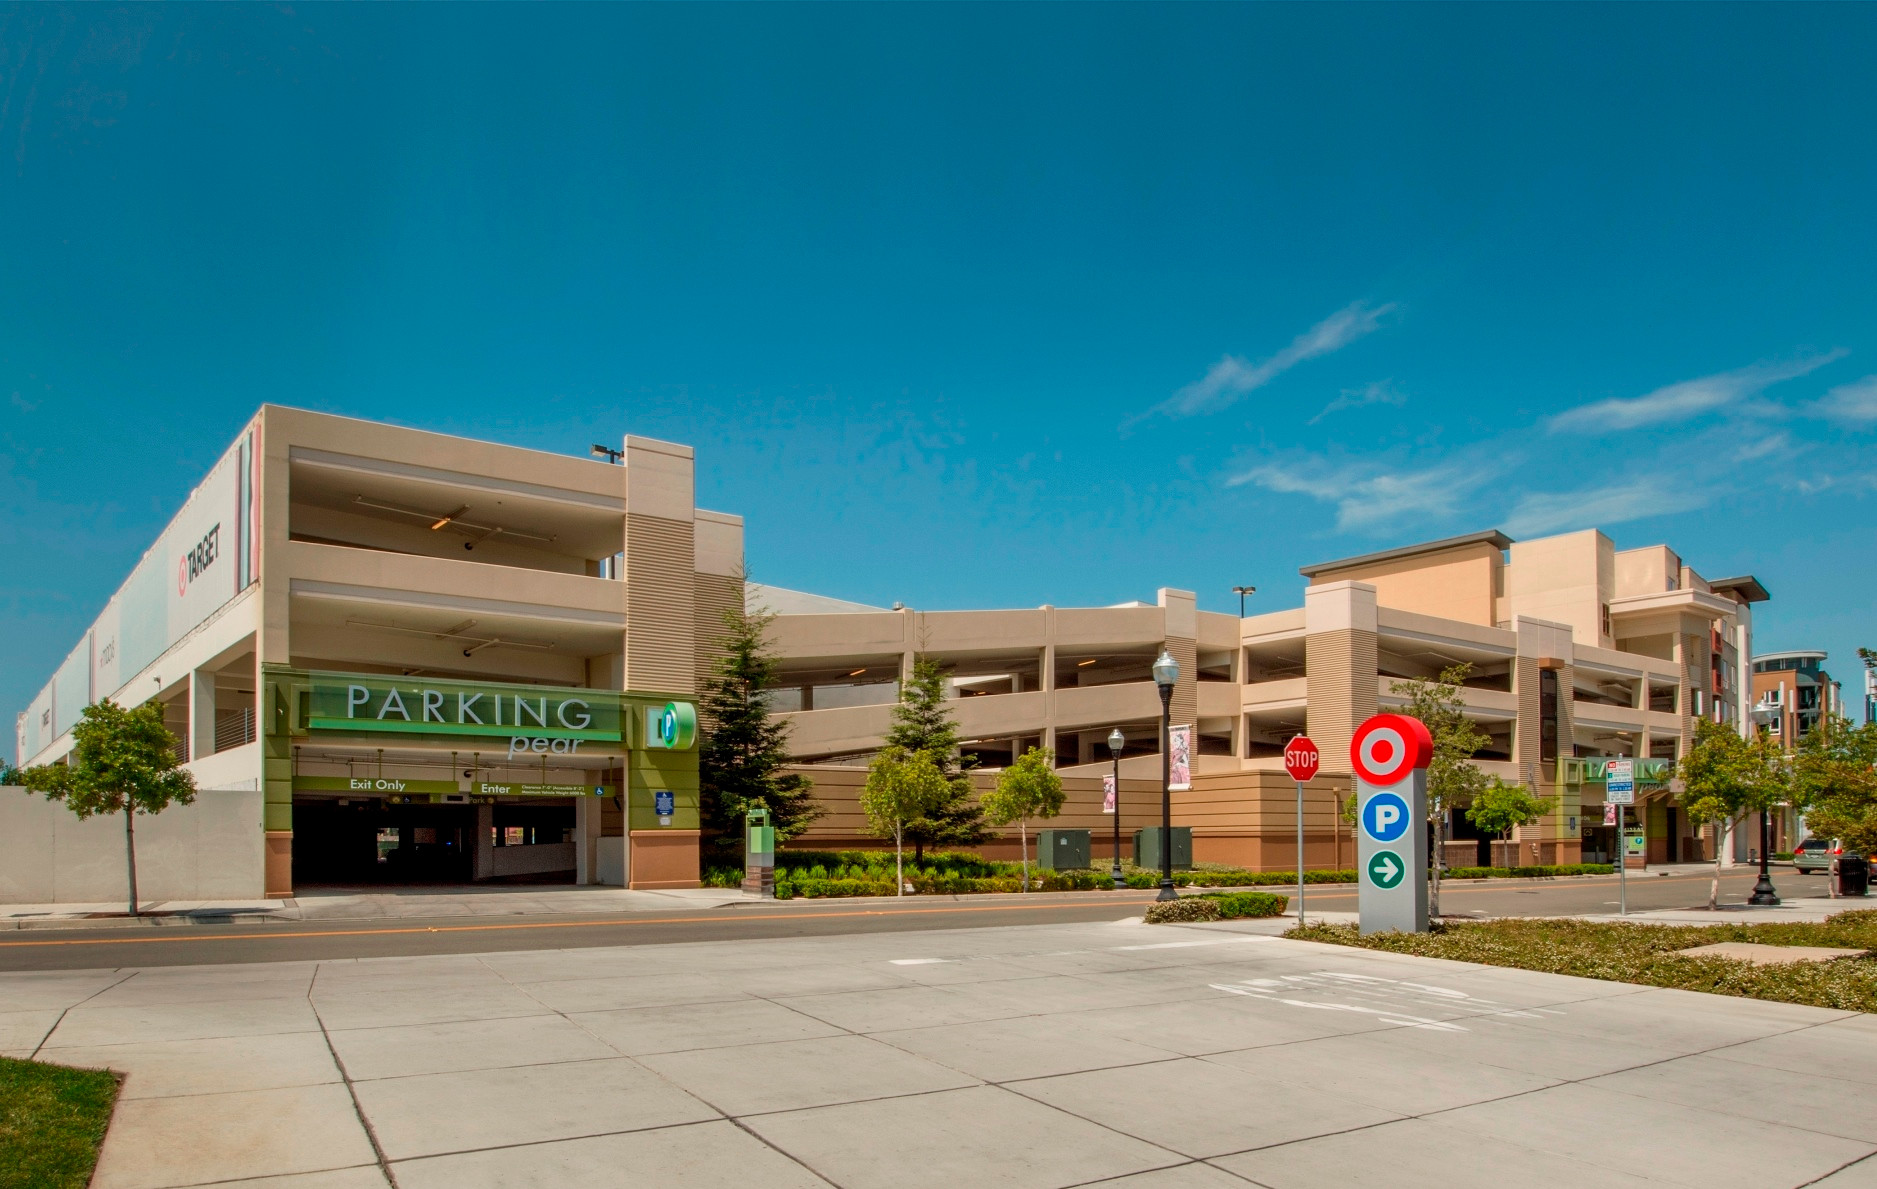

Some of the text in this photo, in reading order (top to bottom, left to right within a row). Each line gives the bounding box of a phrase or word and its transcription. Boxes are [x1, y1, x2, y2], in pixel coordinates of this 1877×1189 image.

[188, 522, 220, 583] TARGET
[347, 684, 592, 730] PARKING
[507, 736, 585, 761] pear
[1286, 750, 1318, 768] STOP
[350, 778, 406, 792] Exit Only
[481, 783, 511, 794] Enter
[1375, 804, 1401, 834] P
